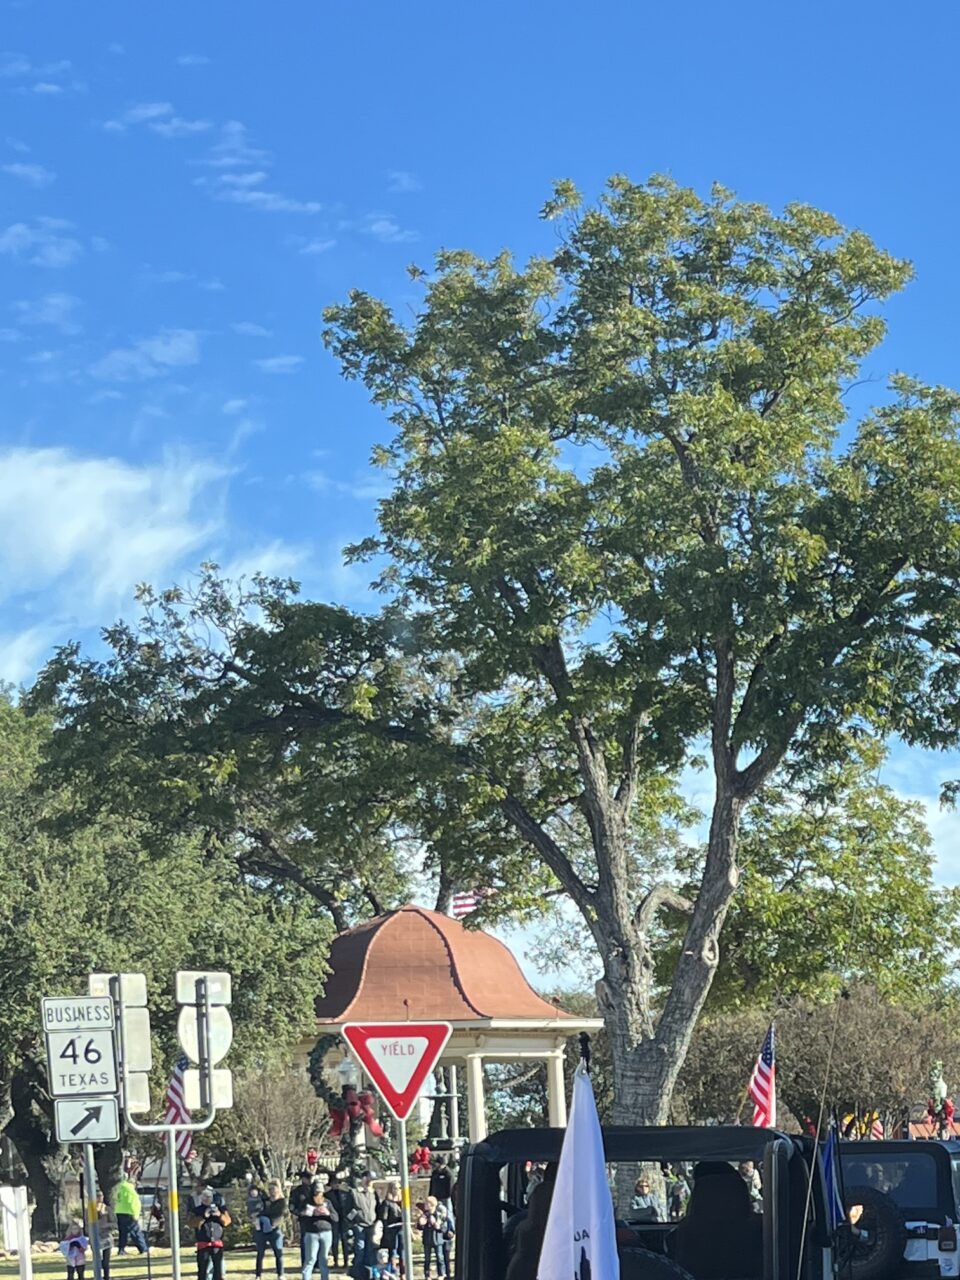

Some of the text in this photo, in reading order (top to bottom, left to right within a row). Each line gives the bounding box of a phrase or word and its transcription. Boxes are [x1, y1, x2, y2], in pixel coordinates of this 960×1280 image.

[46, 1005, 111, 1023] BUSINESS
[60, 1038, 102, 1065] 46
[381, 1044, 415, 1056] YIELD
[59, 1072, 109, 1087] TEXAS
